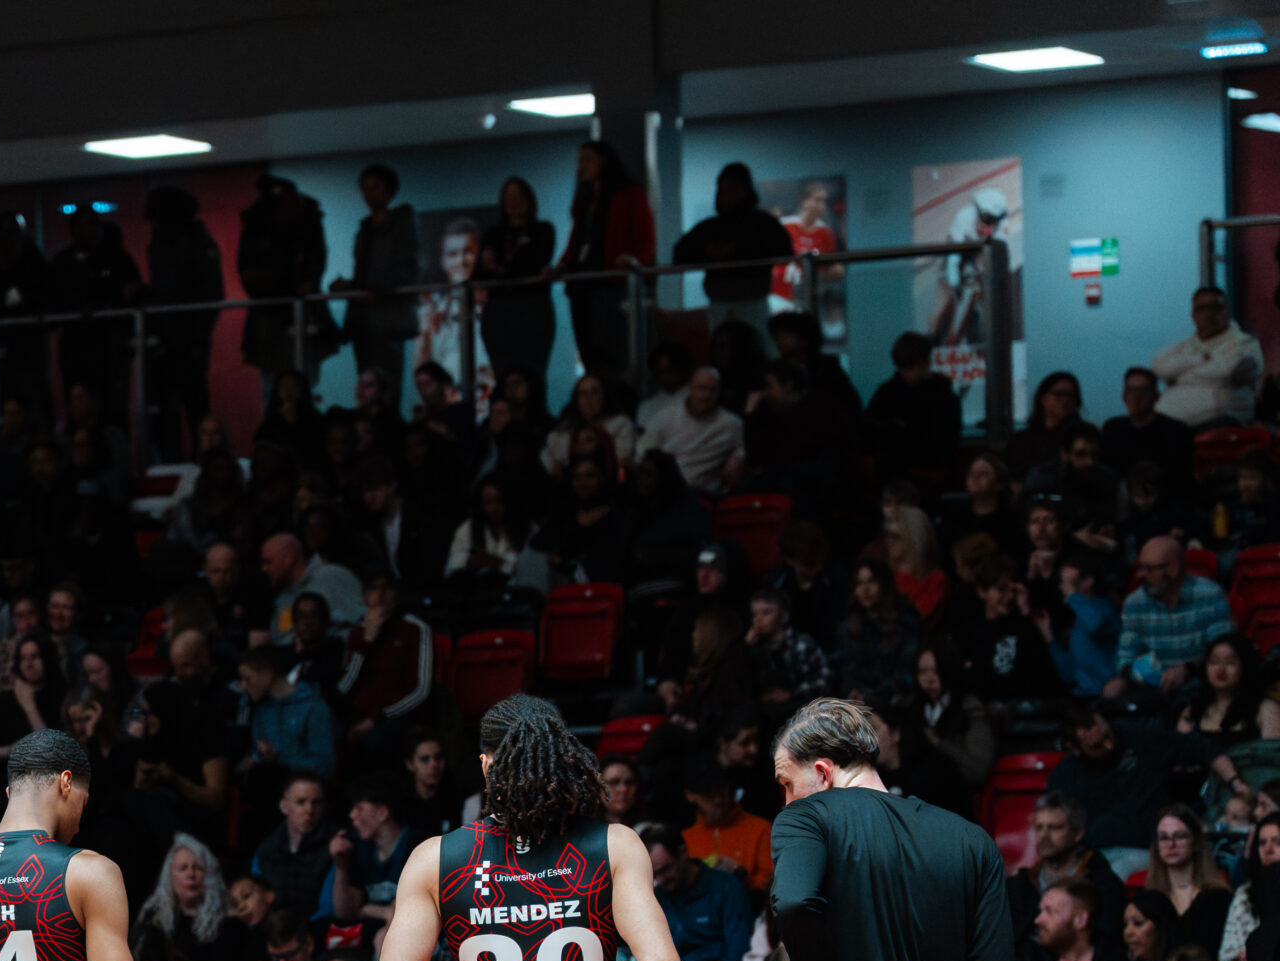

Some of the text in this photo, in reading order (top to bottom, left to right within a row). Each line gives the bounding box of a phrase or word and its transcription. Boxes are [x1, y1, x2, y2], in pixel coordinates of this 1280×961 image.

[0, 877, 6, 885] of
[7, 876, 29, 884] Essex
[494, 867, 572, 882] University of Essex
[470, 900, 581, 925] MENDEZ
